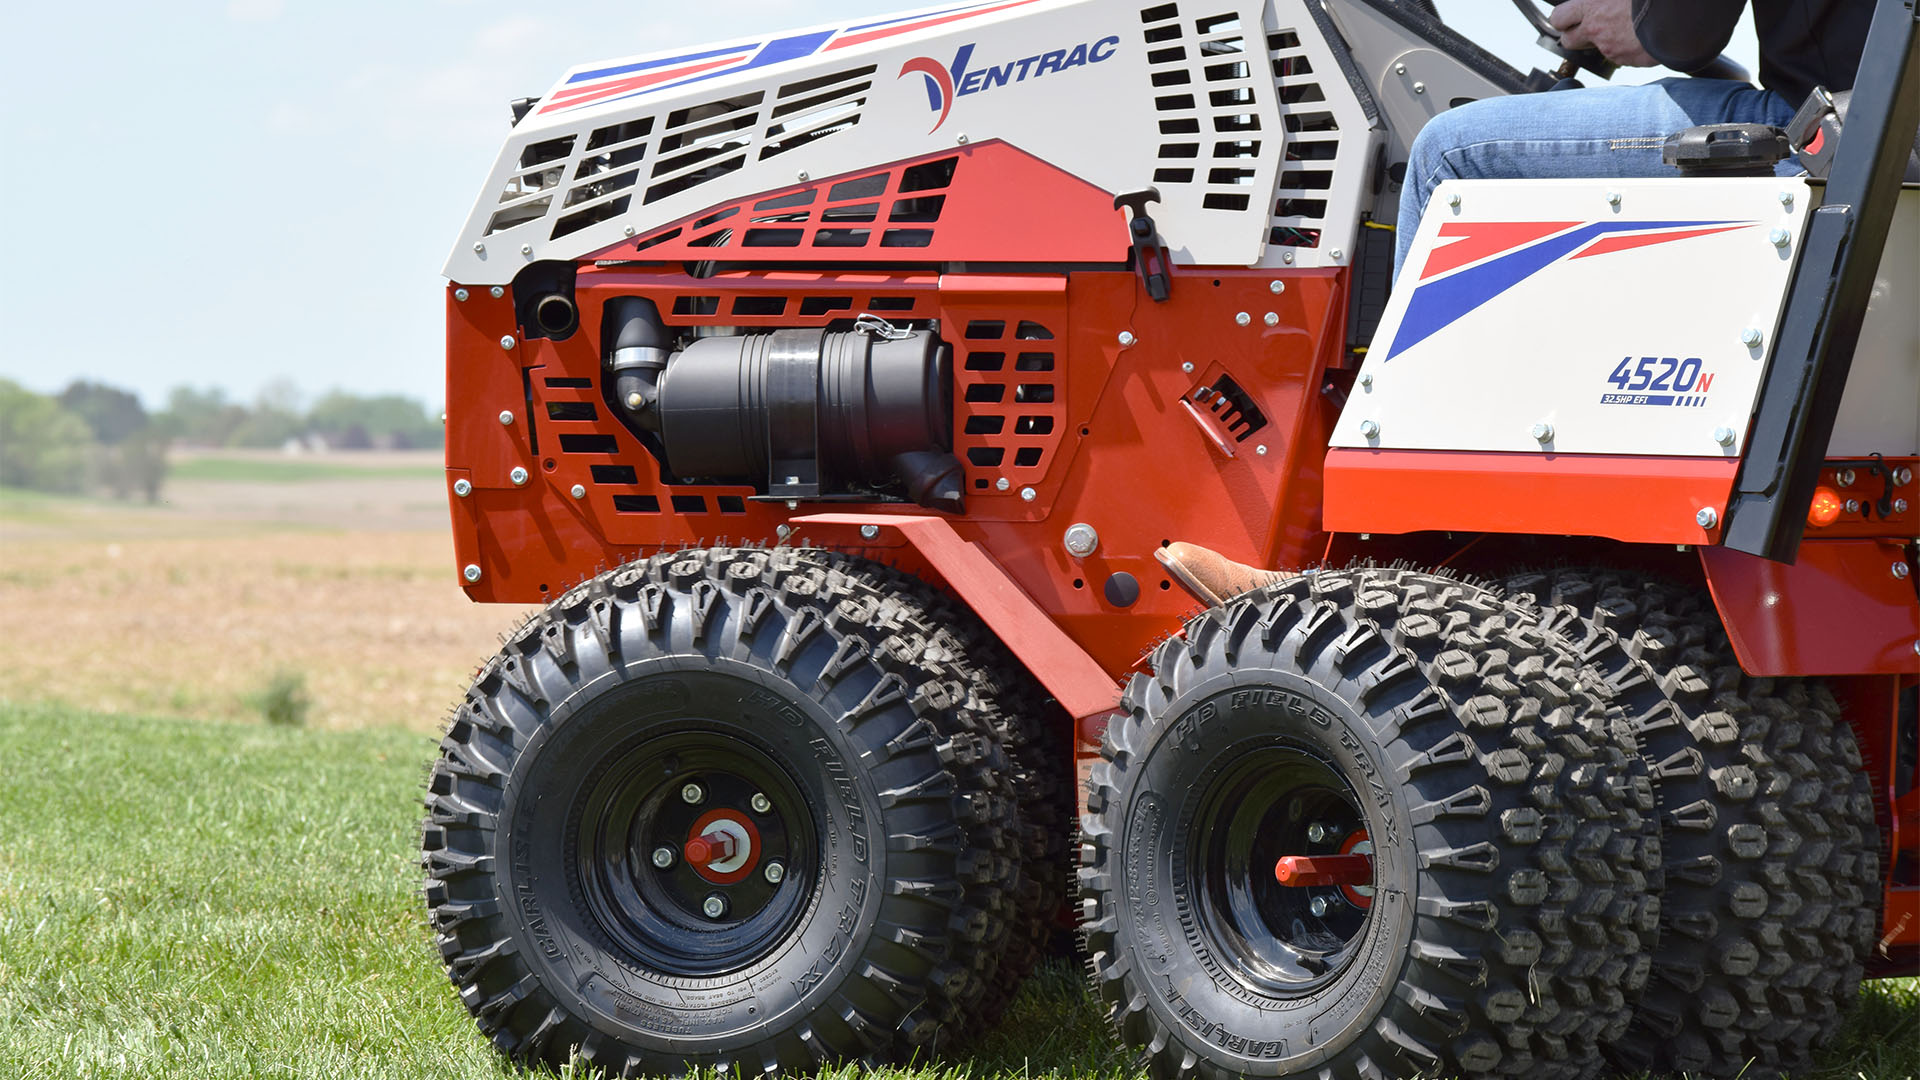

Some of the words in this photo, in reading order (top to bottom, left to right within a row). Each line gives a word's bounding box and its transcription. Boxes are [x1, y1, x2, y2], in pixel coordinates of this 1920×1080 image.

[897, 35, 1120, 135] VENTRAC
[1602, 394, 1632, 404] 32.5HP
[1633, 395, 1649, 404] EFI
[750, 689, 805, 727] HD
[807, 735, 869, 864] FIELD
[1167, 702, 1218, 749] HD
[1231, 689, 1333, 730] FIELD
[1336, 727, 1400, 848] TRAX
[514, 800, 566, 962] CARLISLE
[798, 878, 867, 997] TRAX
[640, 1019, 692, 1034] TUBELESS
[1160, 976, 1289, 1059] CARLISLE
